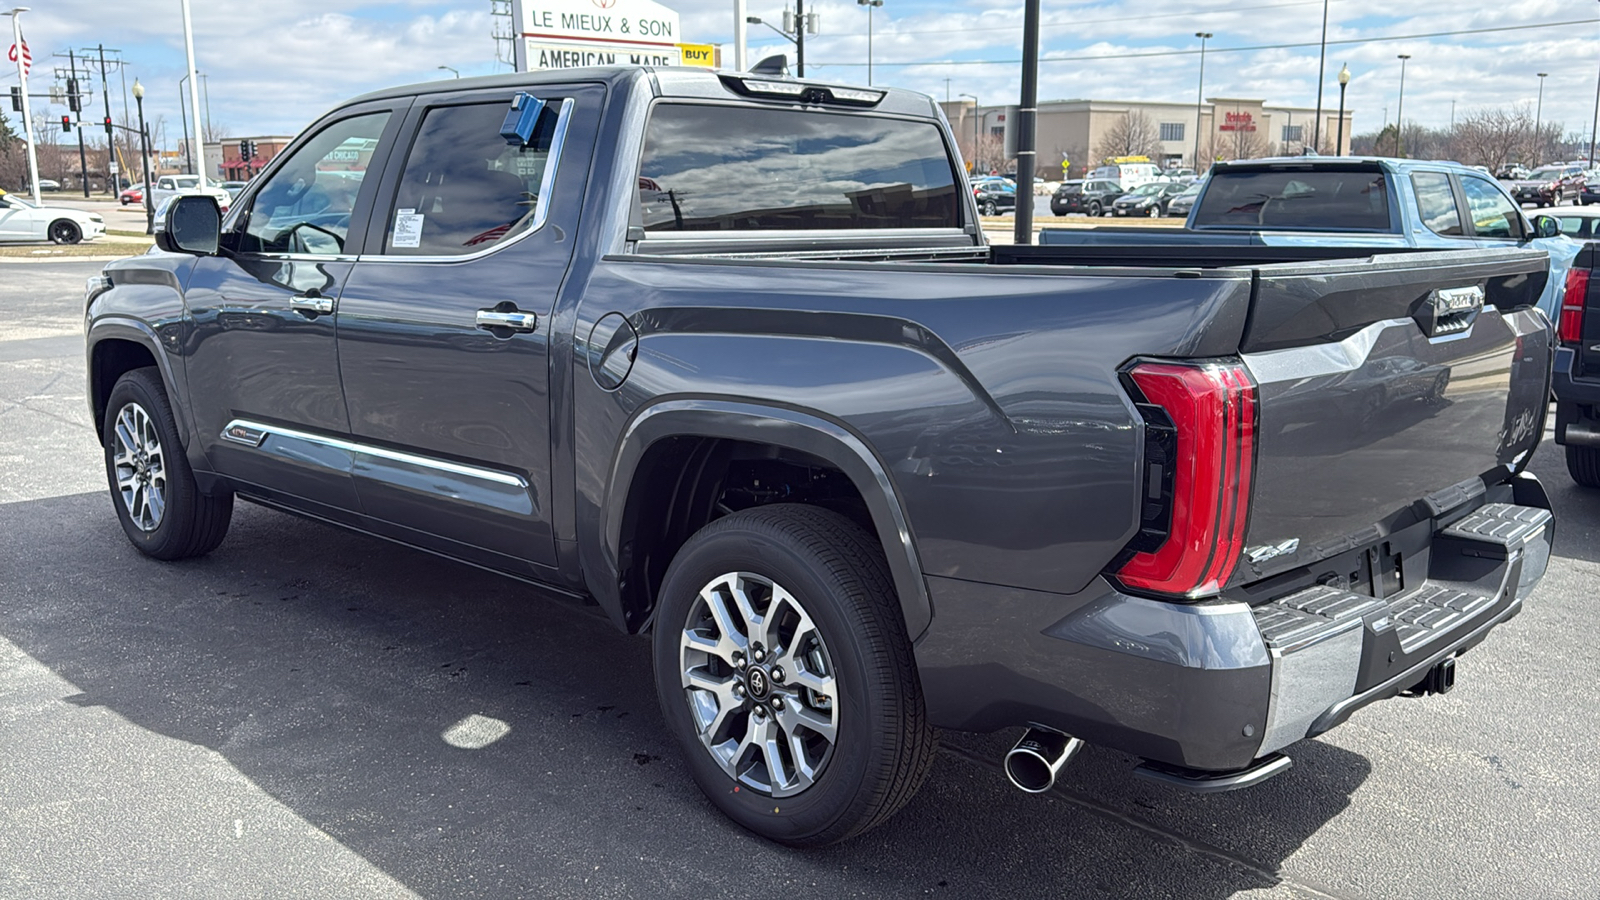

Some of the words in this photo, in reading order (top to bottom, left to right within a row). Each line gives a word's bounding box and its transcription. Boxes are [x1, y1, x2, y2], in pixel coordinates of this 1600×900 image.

[532, 10, 553, 28] LE
[561, 13, 612, 33] MIEUX
[620, 17, 631, 34] &
[639, 19, 672, 37] SON
[539, 49, 615, 68] AMERICAN
[685, 50, 709, 60] BUY
